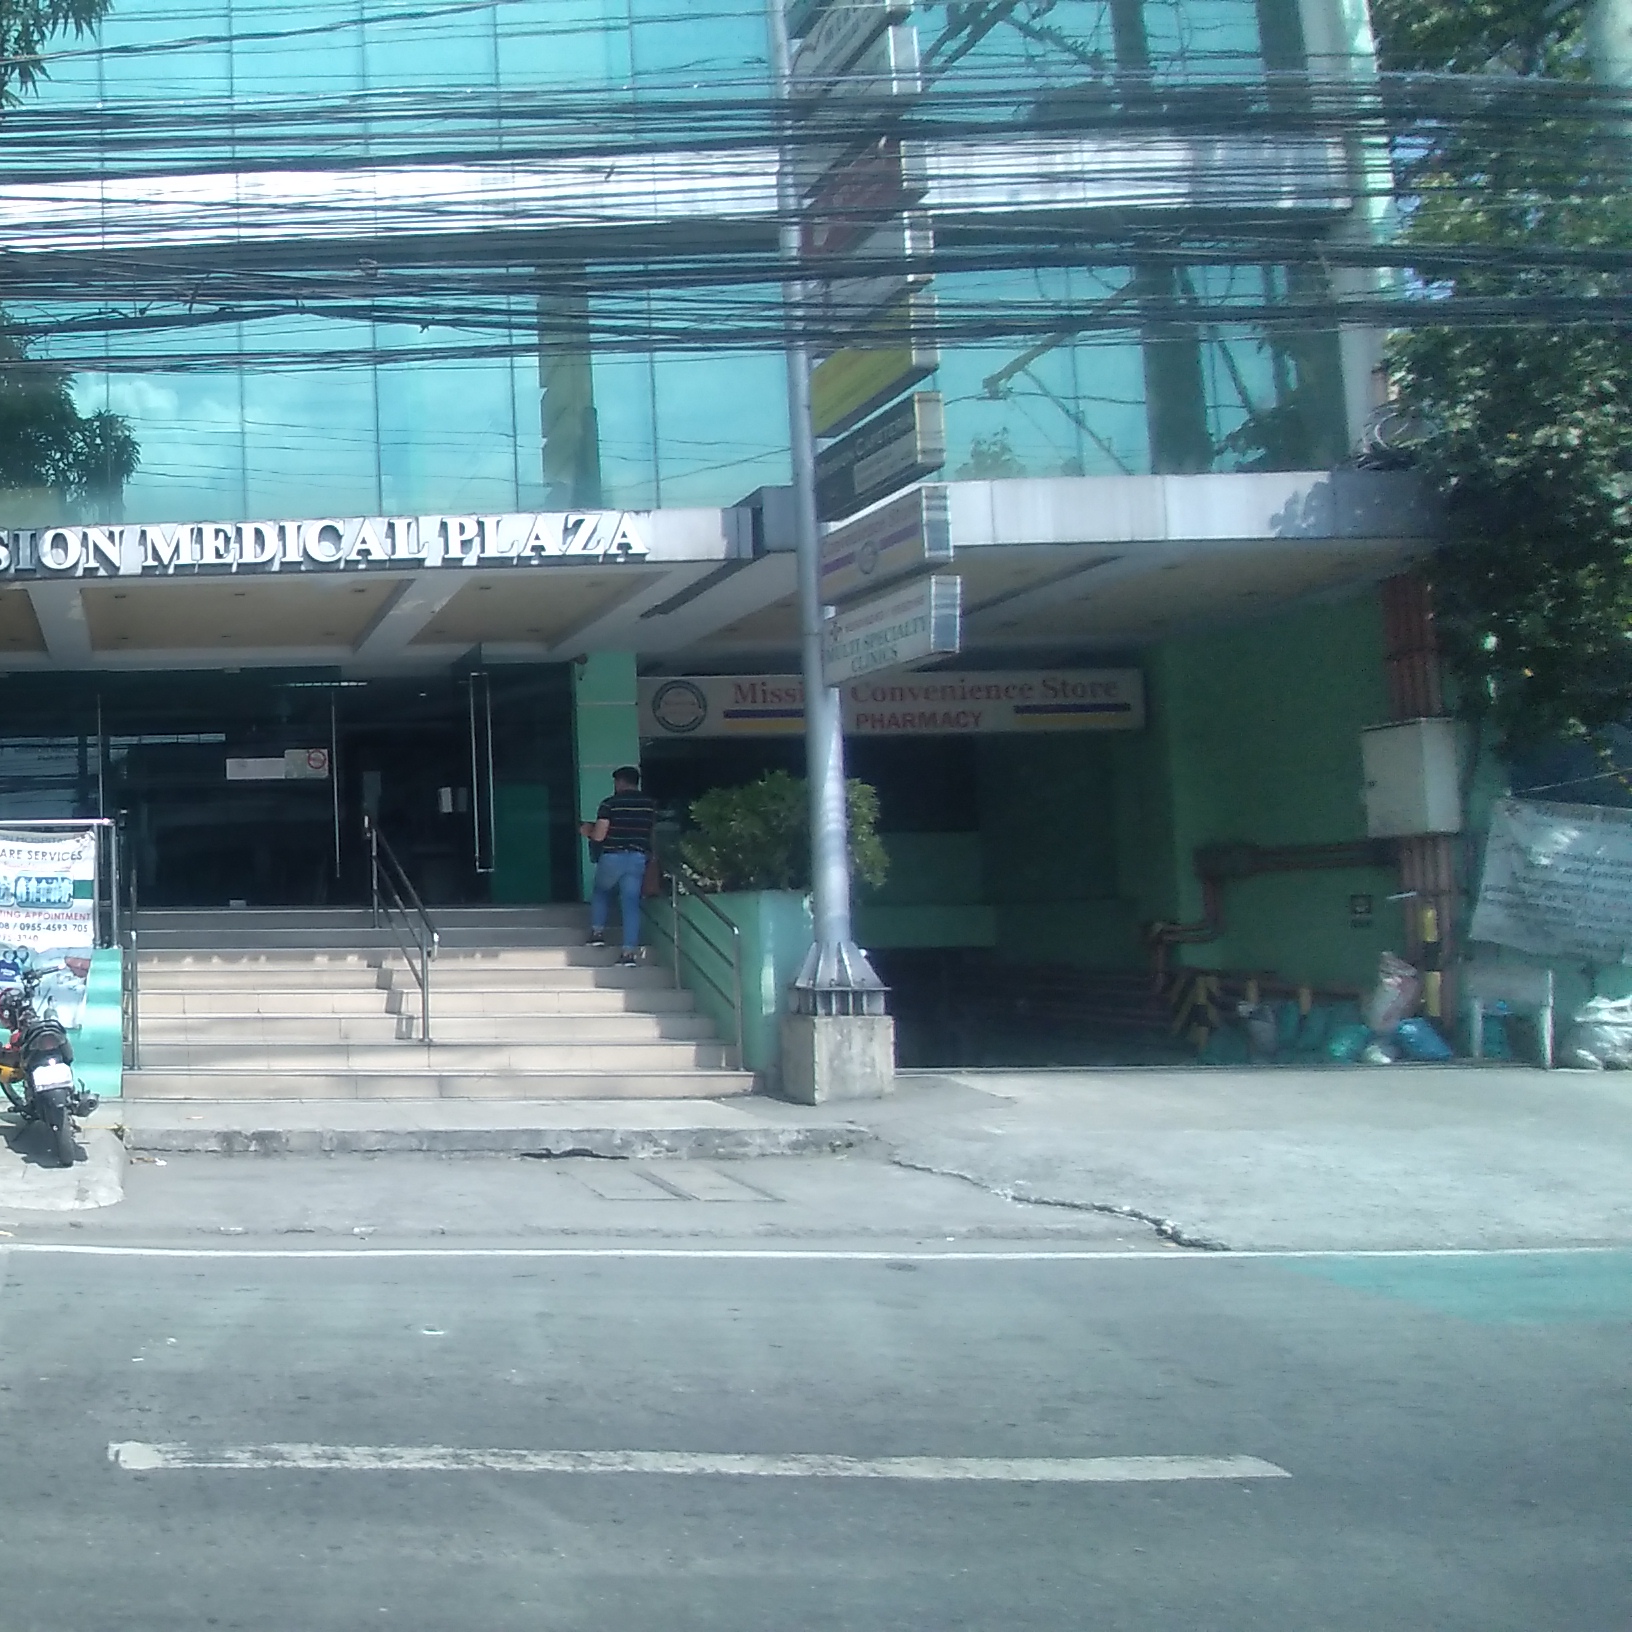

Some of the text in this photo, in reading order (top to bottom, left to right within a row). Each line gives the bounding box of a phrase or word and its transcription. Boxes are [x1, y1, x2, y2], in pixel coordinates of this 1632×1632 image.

[141, 517, 428, 567] MEDICAL
[442, 511, 650, 559] PLAZA
[864, 614, 927, 648] SPECIALTY
[851, 643, 898, 673] CLINICS
[850, 679, 1033, 702] Convenience
[1041, 675, 1118, 700] Store
[855, 711, 982, 730] PHARMACY
[27, 850, 83, 862] SERVICES
